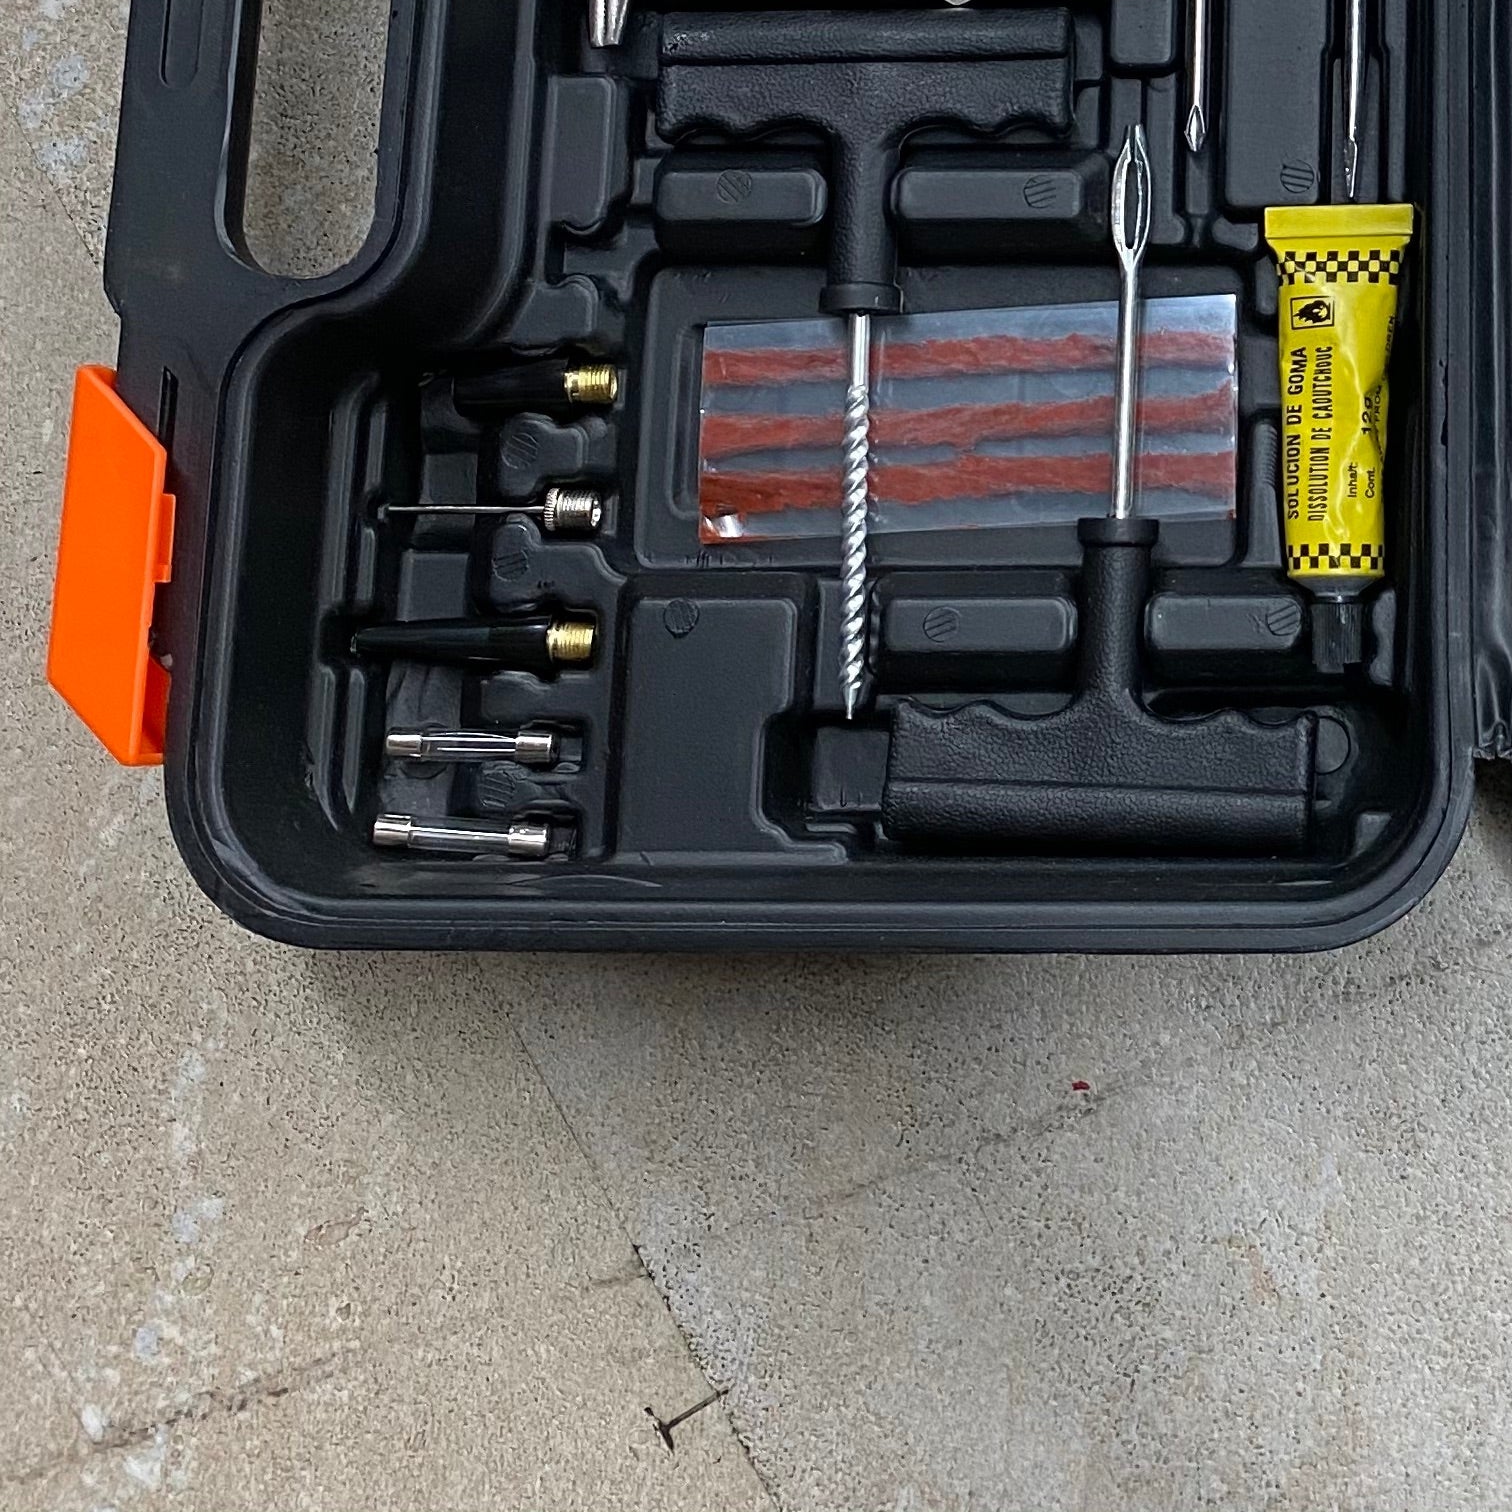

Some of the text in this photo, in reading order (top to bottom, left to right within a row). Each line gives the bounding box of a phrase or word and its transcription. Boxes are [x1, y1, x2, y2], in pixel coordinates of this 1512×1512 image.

[1286, 347, 1307, 519] SOLUCION DE GOMA
[1310, 346, 1333, 522] DISSOLUTION DE CAOUTCHOUC
[1364, 467, 1377, 498] Cont.
